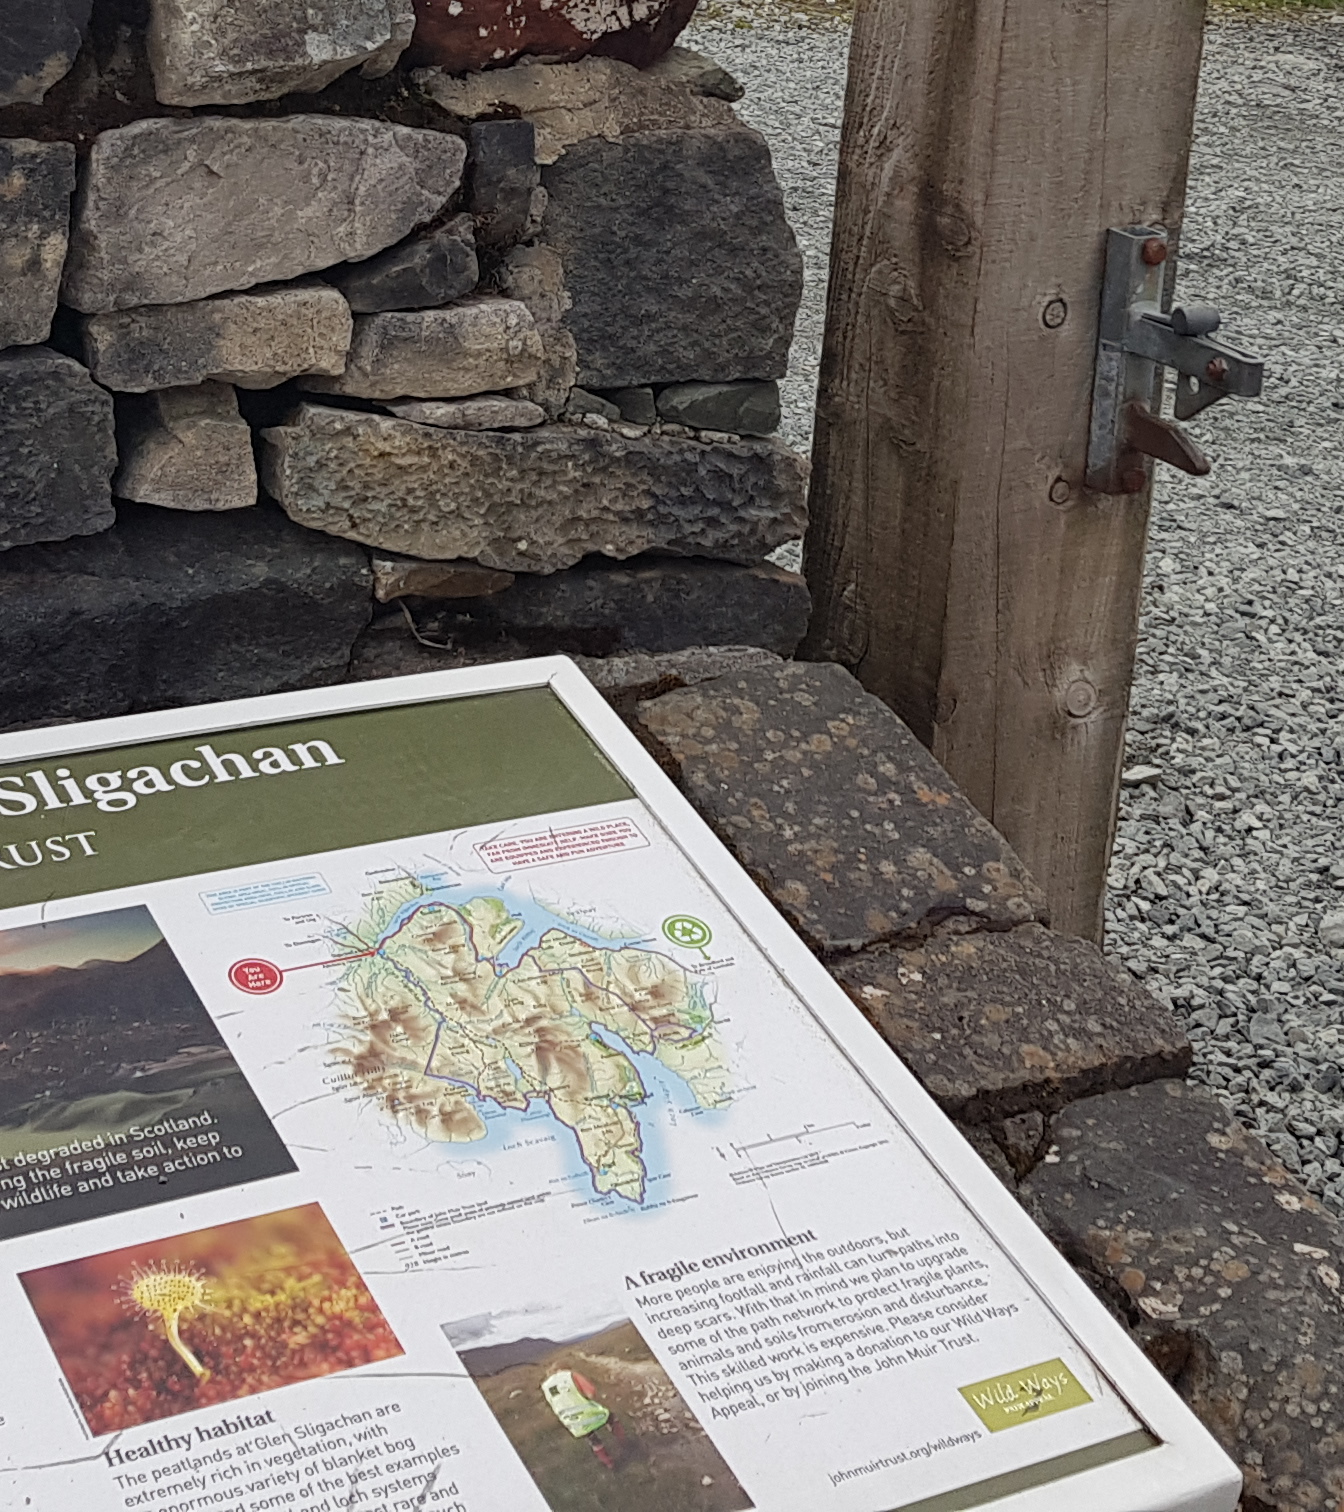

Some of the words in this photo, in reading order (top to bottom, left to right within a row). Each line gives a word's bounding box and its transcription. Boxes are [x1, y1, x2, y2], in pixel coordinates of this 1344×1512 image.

[13, 1133, 106, 1167] degraded
[106, 1131, 128, 1146] in
[128, 1109, 218, 1141] Scotland.
[28, 1162, 62, 1184] the
[64, 1150, 128, 1176] fragile
[131, 1139, 173, 1161] soil,
[172, 1131, 220, 1155] keep
[0, 1182, 73, 1210] wildlife
[76, 1169, 114, 1193] and
[115, 1164, 159, 1183] take
[162, 1150, 221, 1173] action
[222, 1145, 243, 1159] to
[624, 1275, 642, 1291] A
[638, 1259, 701, 1286] fragile
[701, 1228, 818, 1269] environment
[634, 1292, 674, 1309] More
[674, 1277, 721, 1302] people
[721, 1272, 746, 1286] are
[746, 1253, 804, 1279] enjoying
[800, 1250, 826, 1264] the
[825, 1235, 889, 1258] outdoors,
[884, 1226, 911, 1241] but
[644, 1297, 720, 1325] increasing
[717, 1281, 769, 1305] footfall
[767, 1273, 795, 1291] and
[794, 1260, 844, 1284] rainfall
[843, 1256, 869, 1270] can
[866, 1248, 898, 1264] turn
[897, 1238, 935, 1258] paths
[931, 1231, 960, 1246] into
[972, 1384, 1019, 1410] Wild
[1022, 1371, 1068, 1396] Ways
[101, 1428, 198, 1472] Healthy
[193, 1409, 276, 1443] habitat
[111, 1472, 148, 1490] The
[150, 1447, 233, 1484] peatlands
[235, 1440, 253, 1457] at
[253, 1431, 295, 1451] Glen
[293, 1410, 373, 1440] Sligachan
[374, 1402, 402, 1418] are
[123, 1473, 206, 1508] extremely
[209, 1463, 243, 1484] rich
[242, 1459, 262, 1474] in
[262, 1436, 353, 1468] vegetation,
[352, 1423, 389, 1443] with
[828, 1429, 983, 1487] johnmuirtrust.org/wildways
